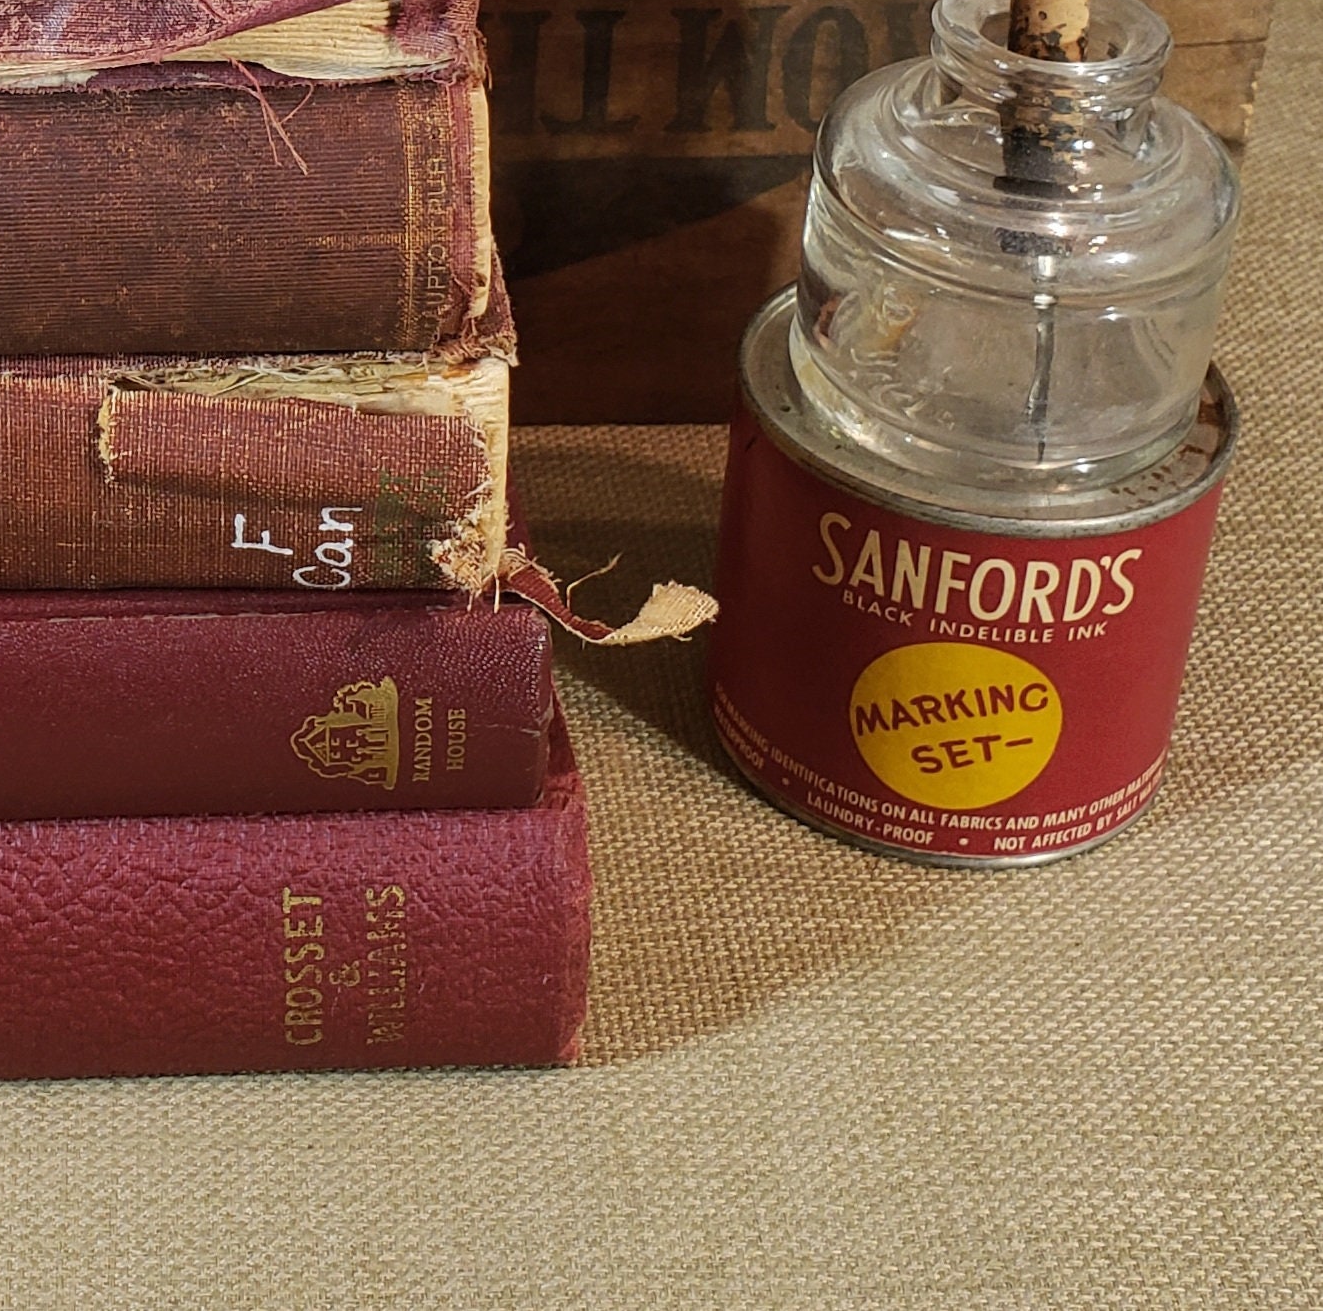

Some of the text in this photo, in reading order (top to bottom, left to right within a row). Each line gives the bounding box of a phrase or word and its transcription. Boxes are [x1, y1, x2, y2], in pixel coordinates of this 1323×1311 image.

[231, 513, 294, 555] F
[292, 507, 364, 590] Can
[812, 512, 1143, 623] SANFORD'S
[843, 590, 1108, 643] BLACK INDELIBLE INK
[412, 697, 433, 782] RANDOM
[446, 708, 467, 771] HOUSE
[855, 682, 1050, 736] MARKING
[771, 746, 878, 812] IDENTIFICATIONS
[881, 802, 906, 820] ON
[908, 809, 935, 825] ALL
[940, 813, 1002, 830] FABRICS
[1006, 816, 1039, 830] AND
[1043, 805, 1086, 828] MANY
[1089, 788, 1125, 816] OTHER
[994, 836, 1026, 851] NOT
[1031, 822, 1092, 848] AFFECTED
[1096, 812, 1113, 831] BY
[1116, 795, 1138, 822] SALT
[282, 887, 325, 1045] CROSSET
[329, 960, 361, 987] &
[365, 885, 407, 1045] WILLIAMS
